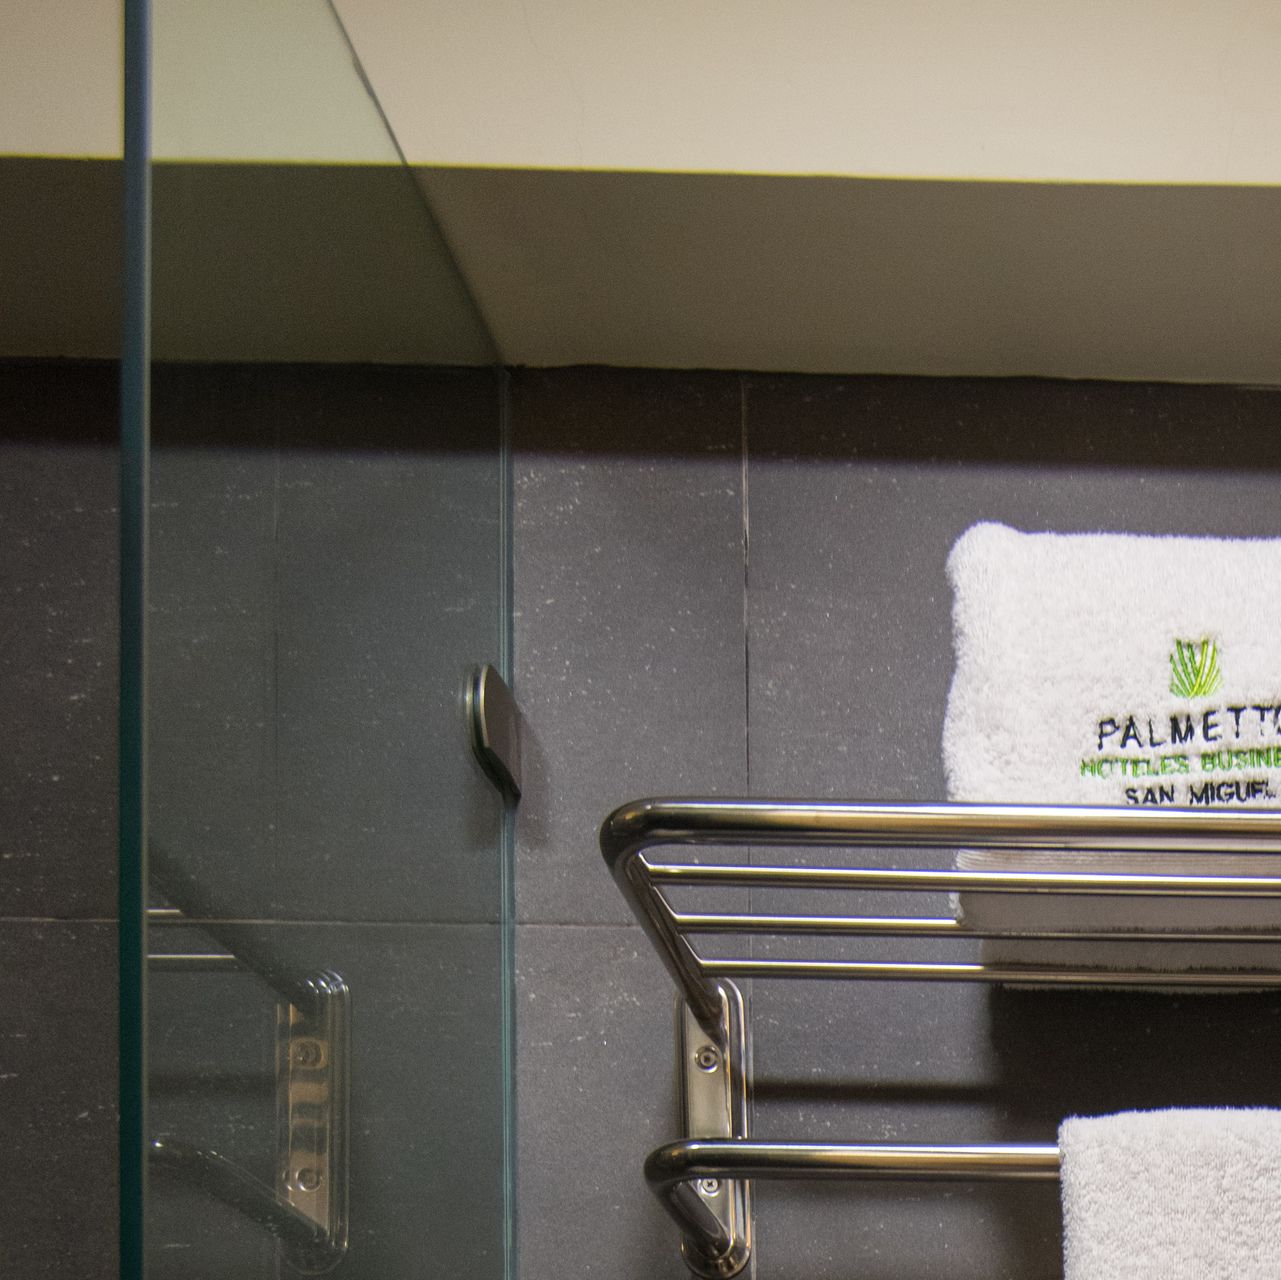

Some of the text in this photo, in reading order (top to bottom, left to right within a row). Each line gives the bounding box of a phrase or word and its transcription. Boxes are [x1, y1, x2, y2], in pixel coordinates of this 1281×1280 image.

[1080, 753, 1190, 778] HOTELES
[1124, 778, 1276, 805] SAN MIGUEL
